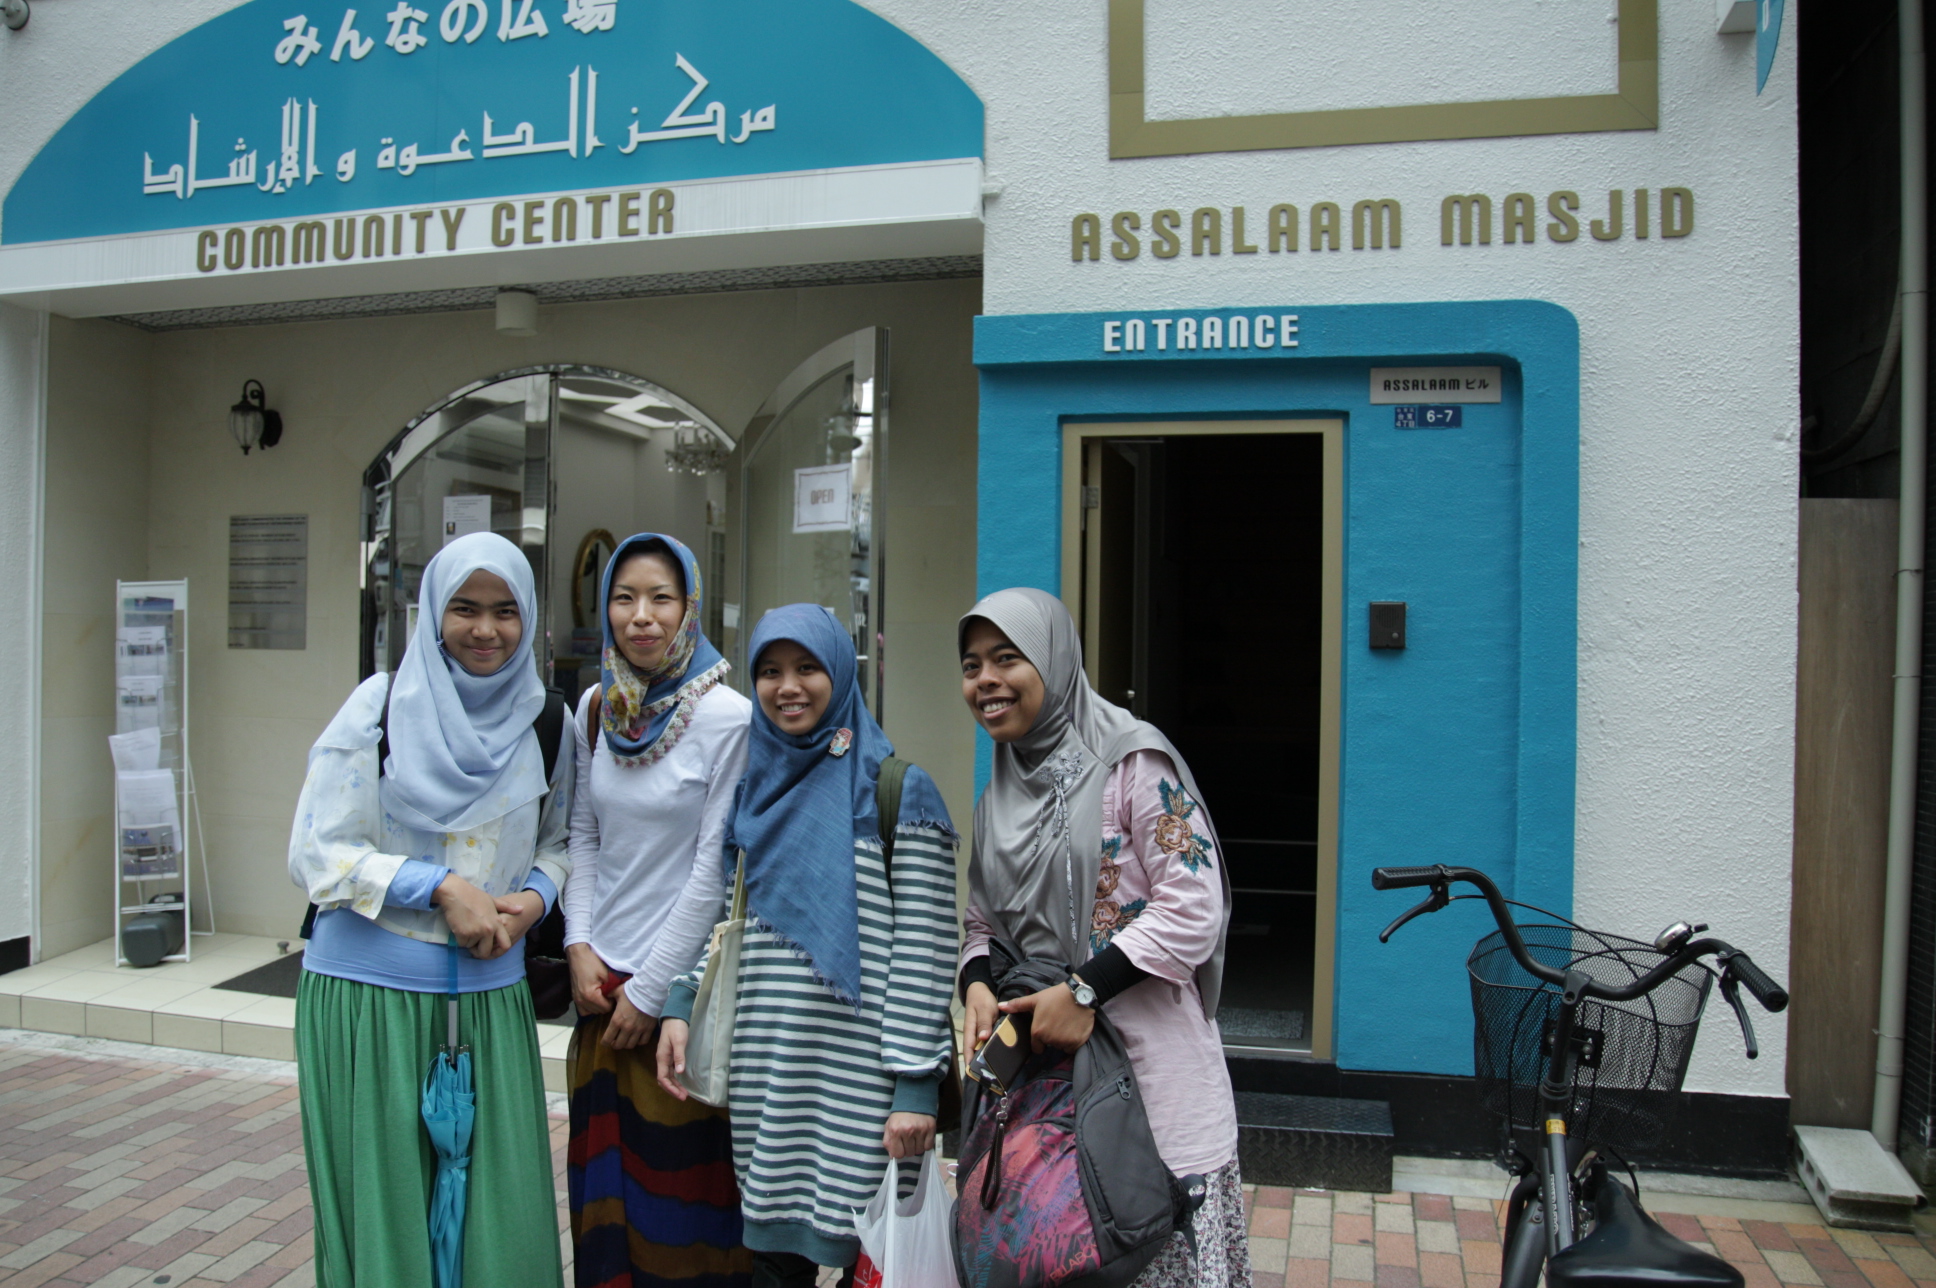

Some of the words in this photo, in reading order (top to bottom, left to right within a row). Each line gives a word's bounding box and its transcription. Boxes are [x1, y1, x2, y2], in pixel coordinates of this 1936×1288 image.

[275, 0, 617, 66] みんなの広場
[377, 65, 605, 176] الدعوة
[618, 52, 776, 154] مركز
[336, 148, 356, 182] و
[197, 207, 466, 273] COMMUNITY
[492, 189, 676, 248] CENTER
[1072, 199, 1402, 262] ASSALAAM
[1441, 187, 1694, 246] MASJID
[1104, 315, 1299, 353] ENTRANCE
[1383, 379, 1460, 391] ASSALAAM
[1465, 378, 1489, 390] ビル
[1426, 409, 1453, 423] 6-7
[810, 489, 834, 505] OPEN
